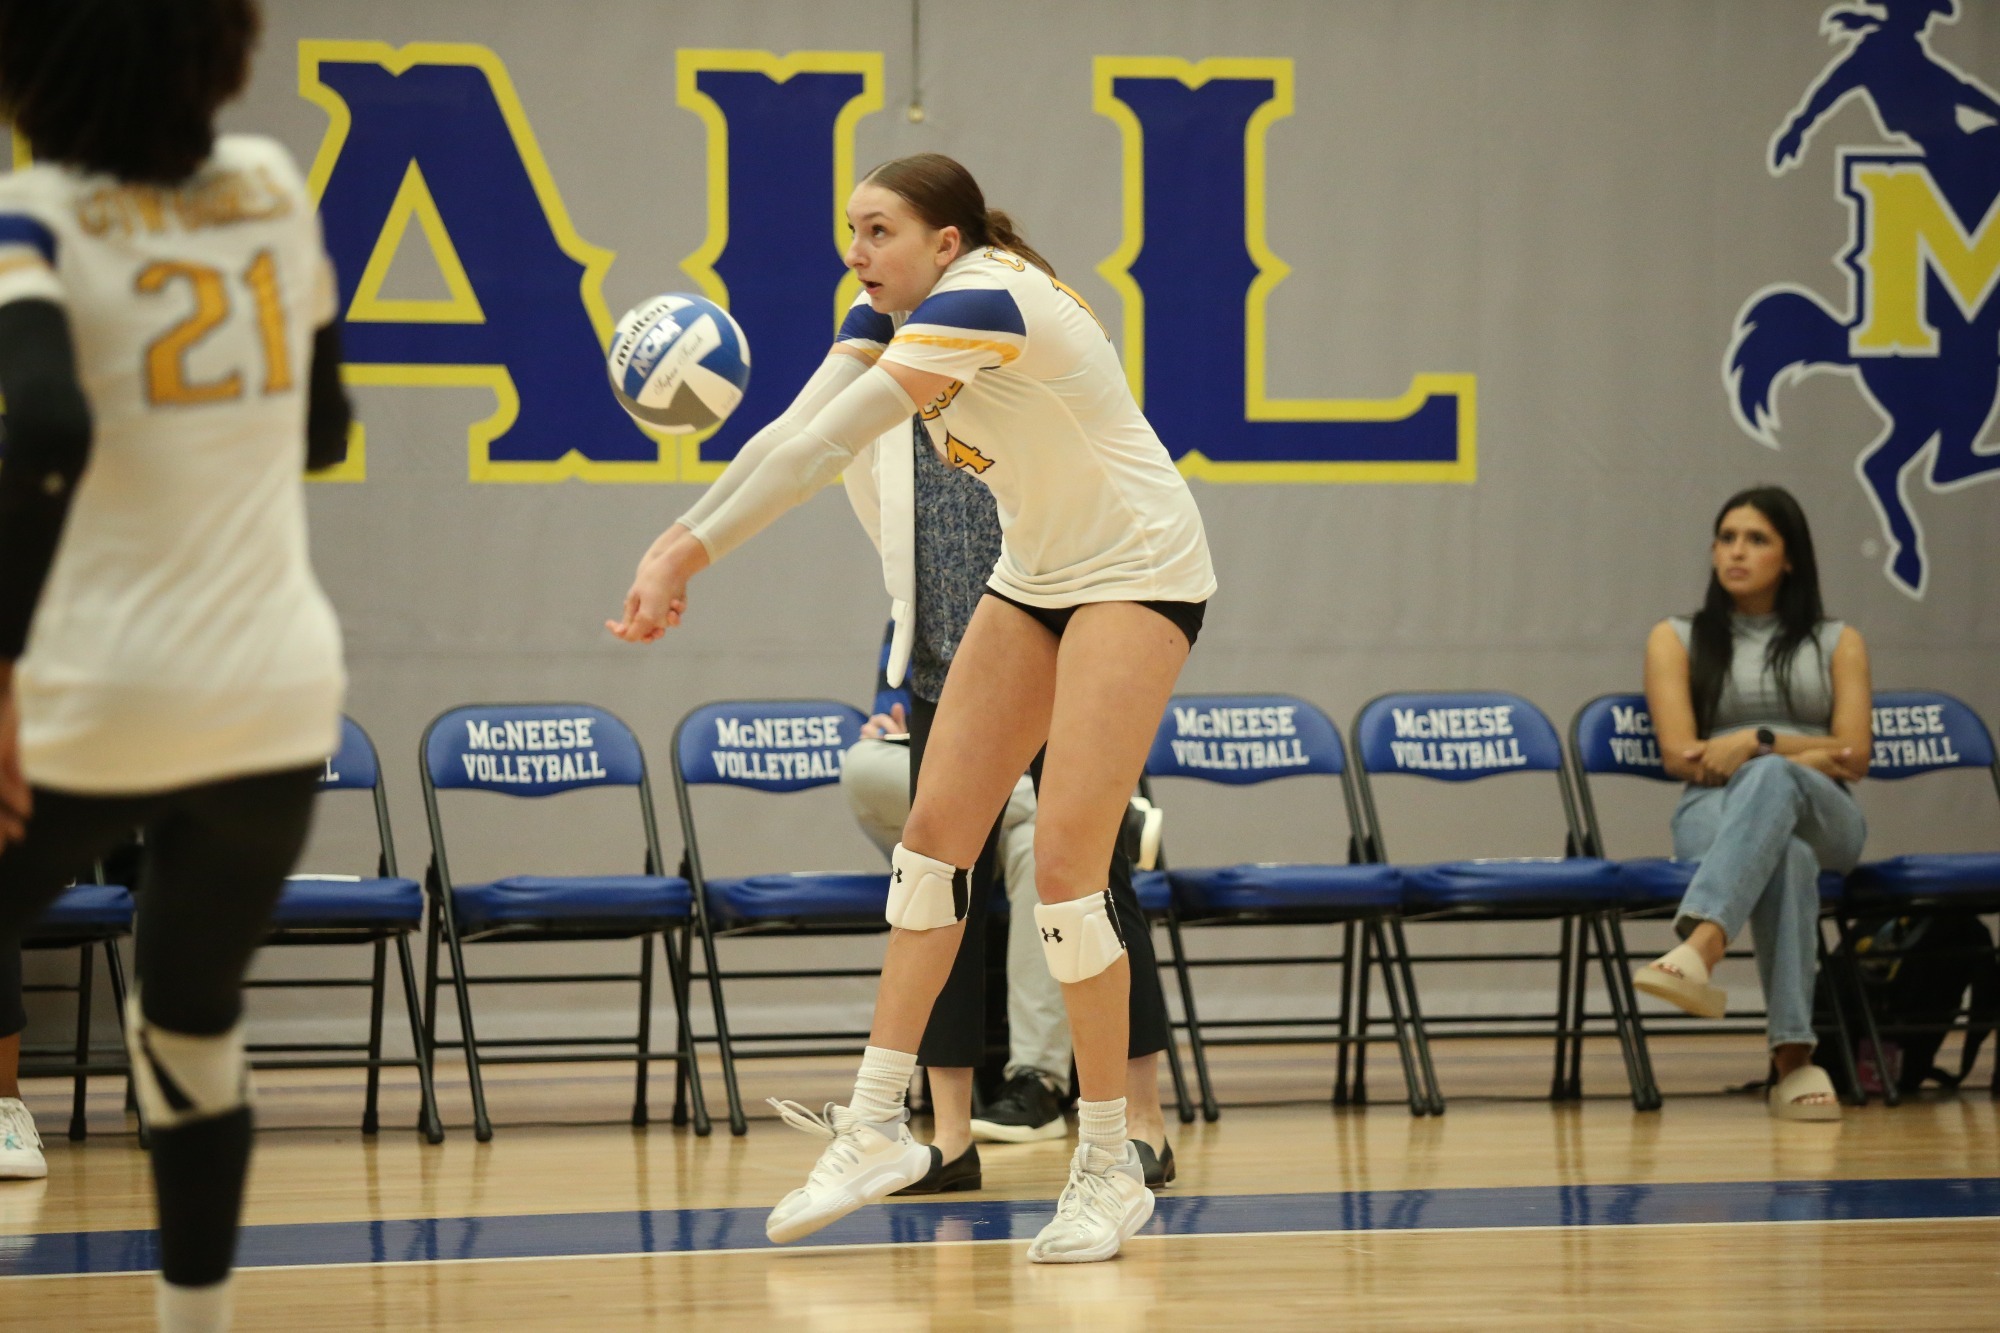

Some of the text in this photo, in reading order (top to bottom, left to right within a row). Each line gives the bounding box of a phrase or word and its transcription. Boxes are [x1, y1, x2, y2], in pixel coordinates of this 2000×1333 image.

[0, 38, 1477, 484] ALL
[1848, 160, 2000, 357] M
[134, 247, 292, 405] 21
[617, 303, 670, 367] molten
[631, 315, 683, 379] NCAA
[466, 718, 595, 750] McNEESE
[715, 715, 843, 748] McNEESE
[1173, 706, 1297, 738] McNEESE
[1392, 705, 1514, 738] McNEESE
[462, 751, 607, 784] VOLLEYBALL
[1171, 739, 1310, 770] VOLLEYBALL
[1390, 738, 1527, 770] VOLLEYBALL
[1869, 736, 1960, 767] EYBALL
